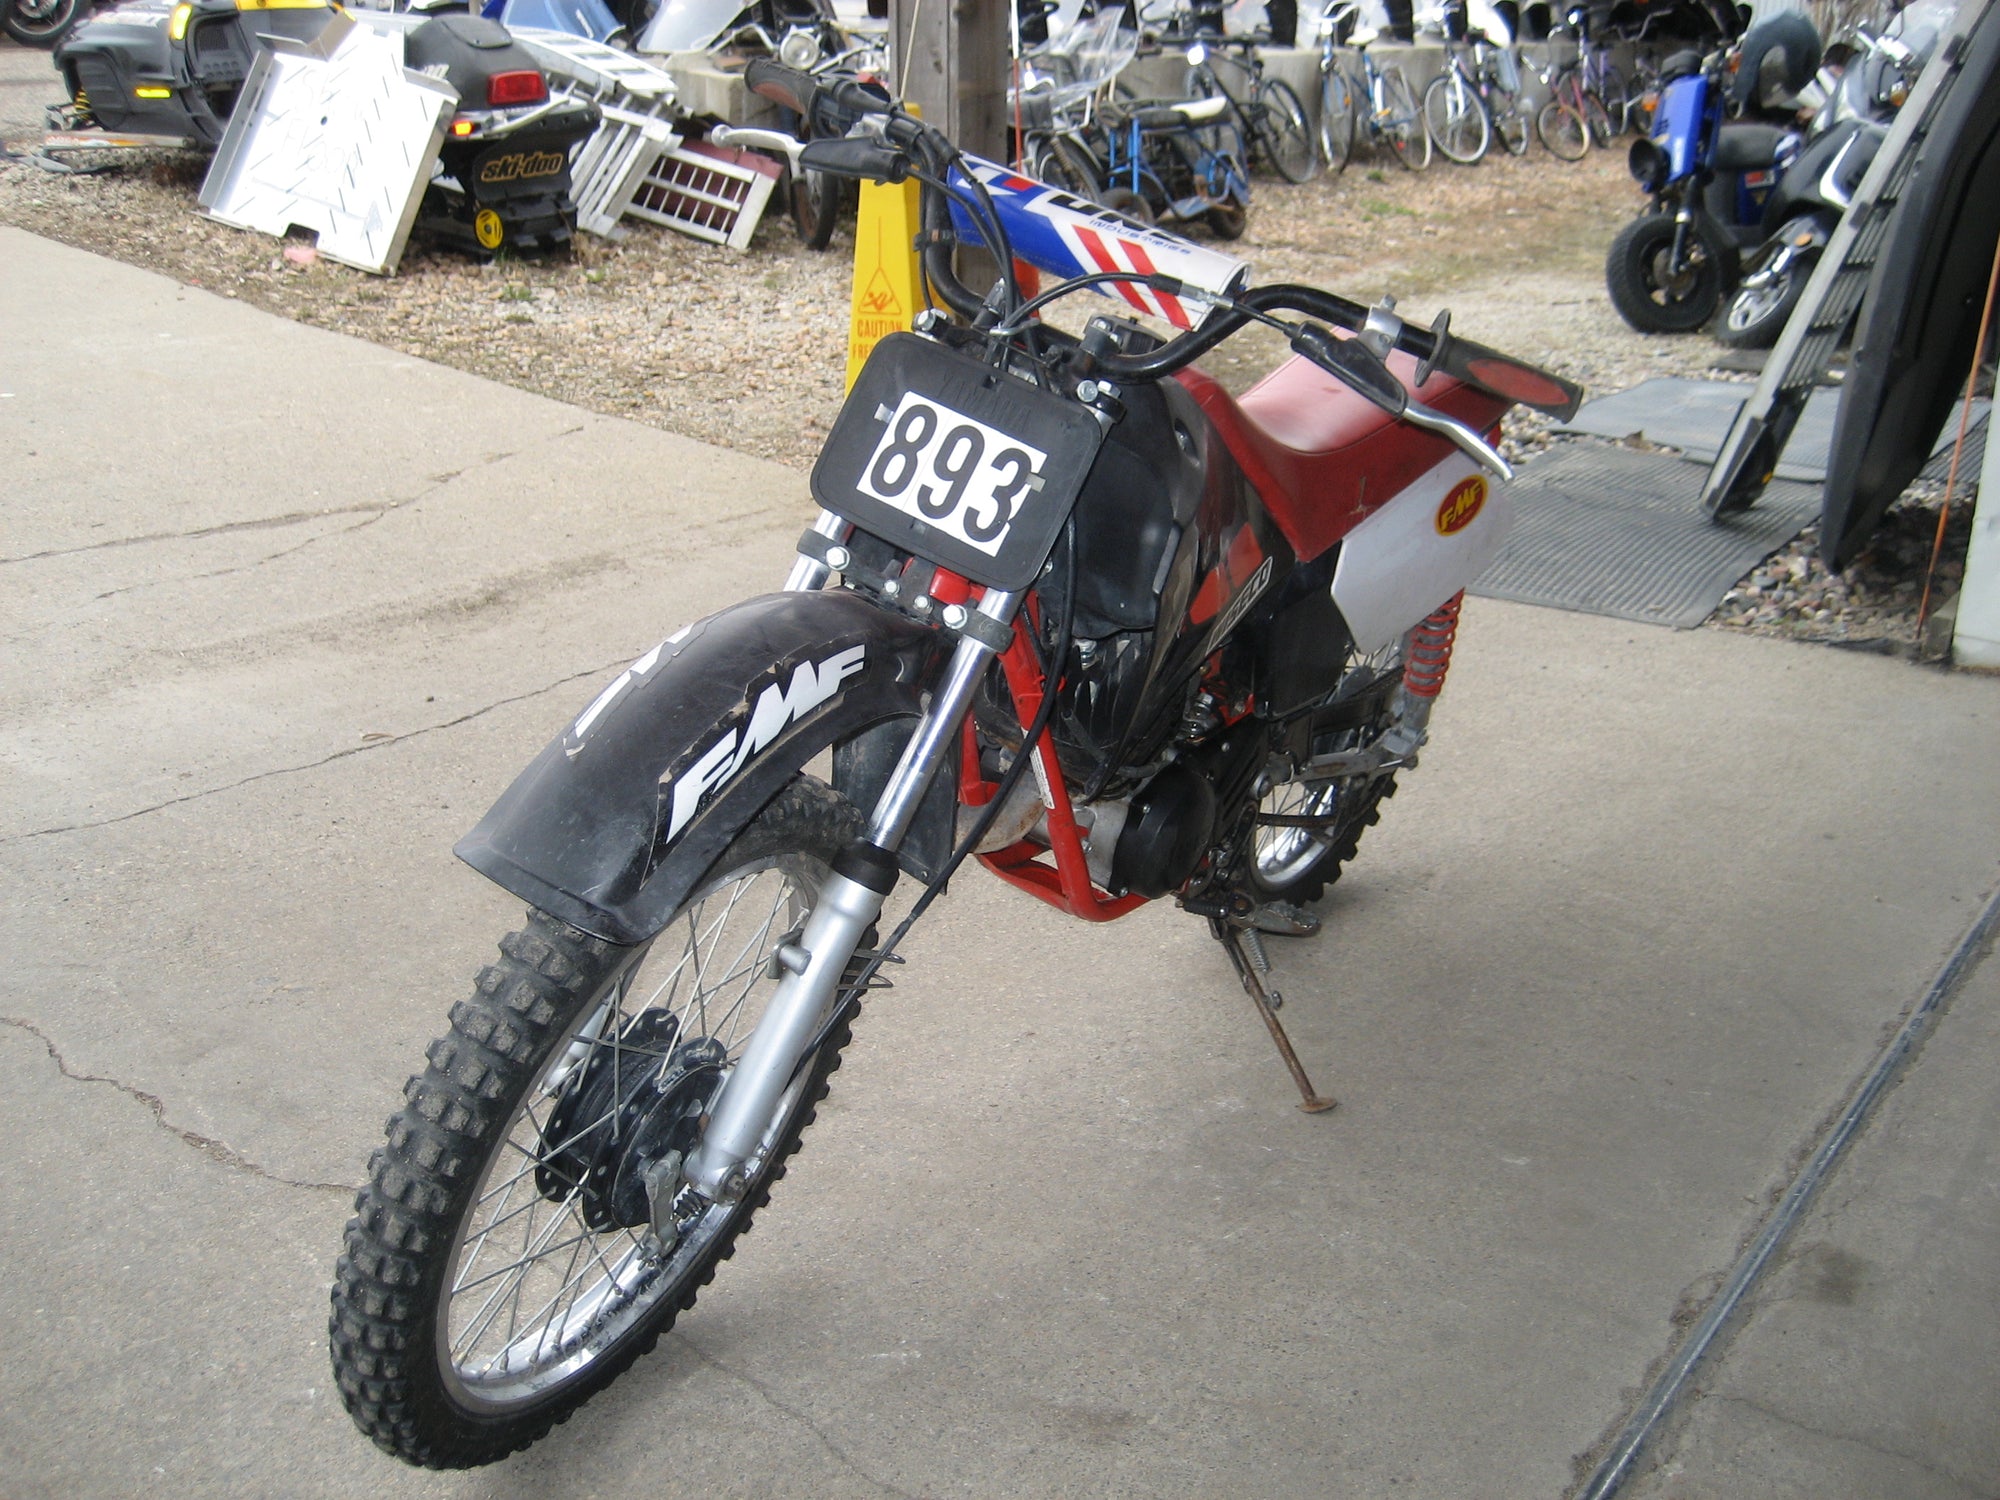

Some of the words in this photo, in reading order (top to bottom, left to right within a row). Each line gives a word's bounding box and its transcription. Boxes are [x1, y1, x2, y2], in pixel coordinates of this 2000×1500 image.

[1090, 219, 1191, 254] INDUSTRIES
[857, 320, 902, 338] CAUTION
[870, 404, 1032, 543] 893
[1441, 481, 1481, 532] FMF
[666, 644, 865, 844] FMF
